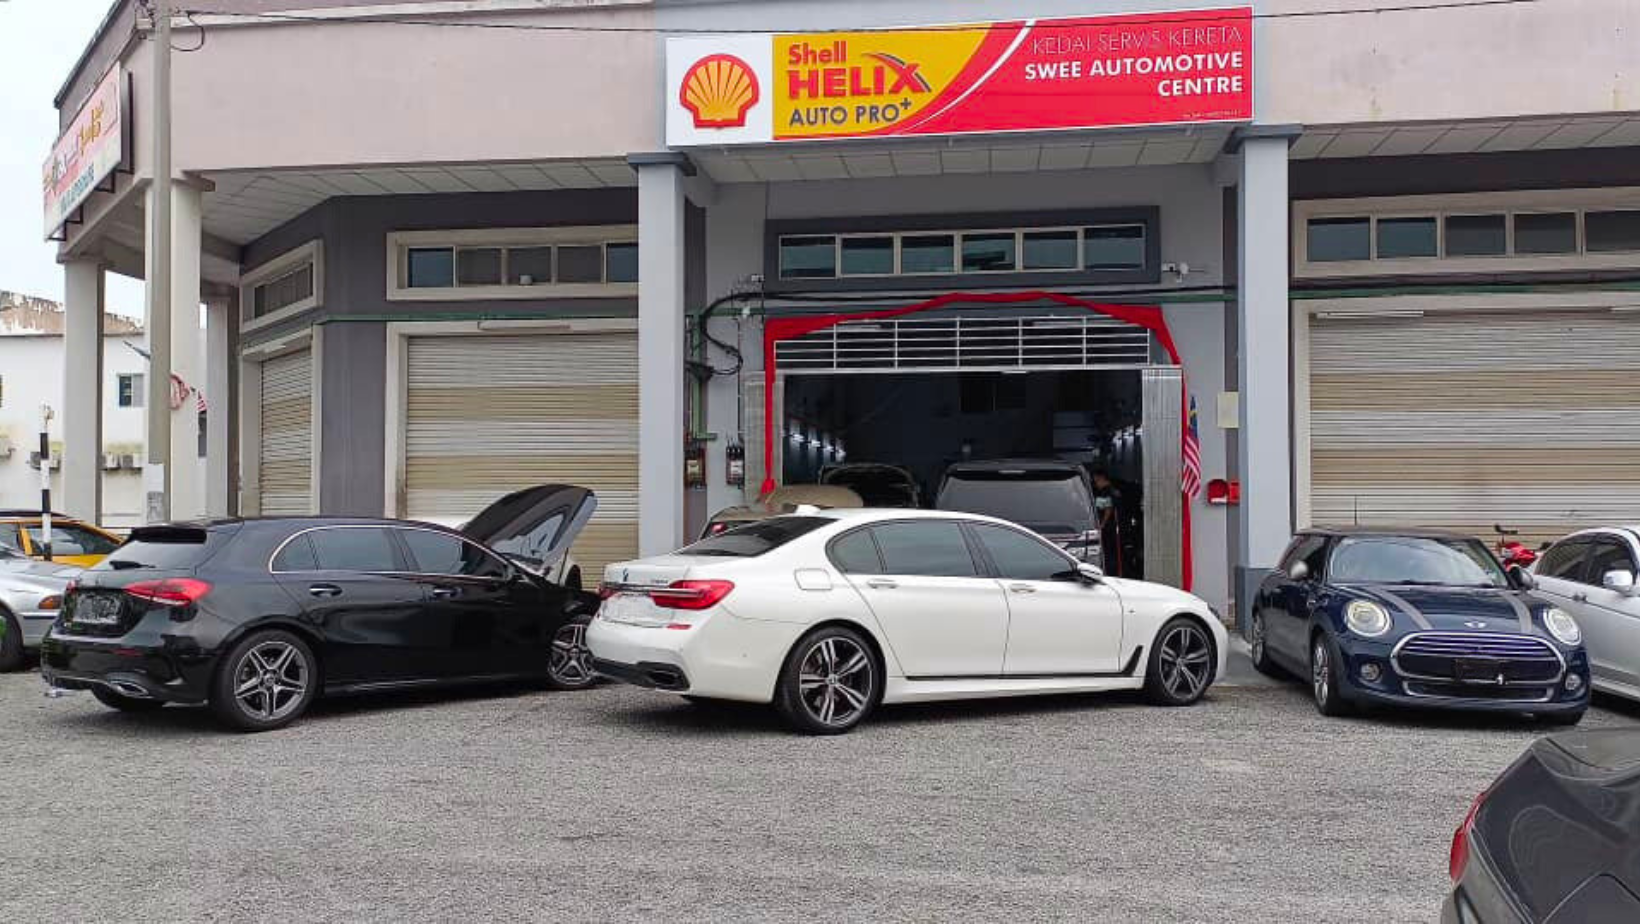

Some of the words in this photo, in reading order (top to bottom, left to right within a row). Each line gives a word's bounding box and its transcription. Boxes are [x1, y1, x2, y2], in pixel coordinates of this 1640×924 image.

[788, 41, 847, 65] Shell
[1033, 34, 1091, 54] KEDAI
[1099, 29, 1161, 50] SERVS
[1168, 26, 1243, 48] KERETA
[788, 53, 932, 99] HELIX
[1025, 60, 1081, 80] SWEE
[1090, 51, 1243, 77] AUTOMOTIVE
[1157, 76, 1243, 97] CENTRE
[789, 106, 848, 126] AUTO
